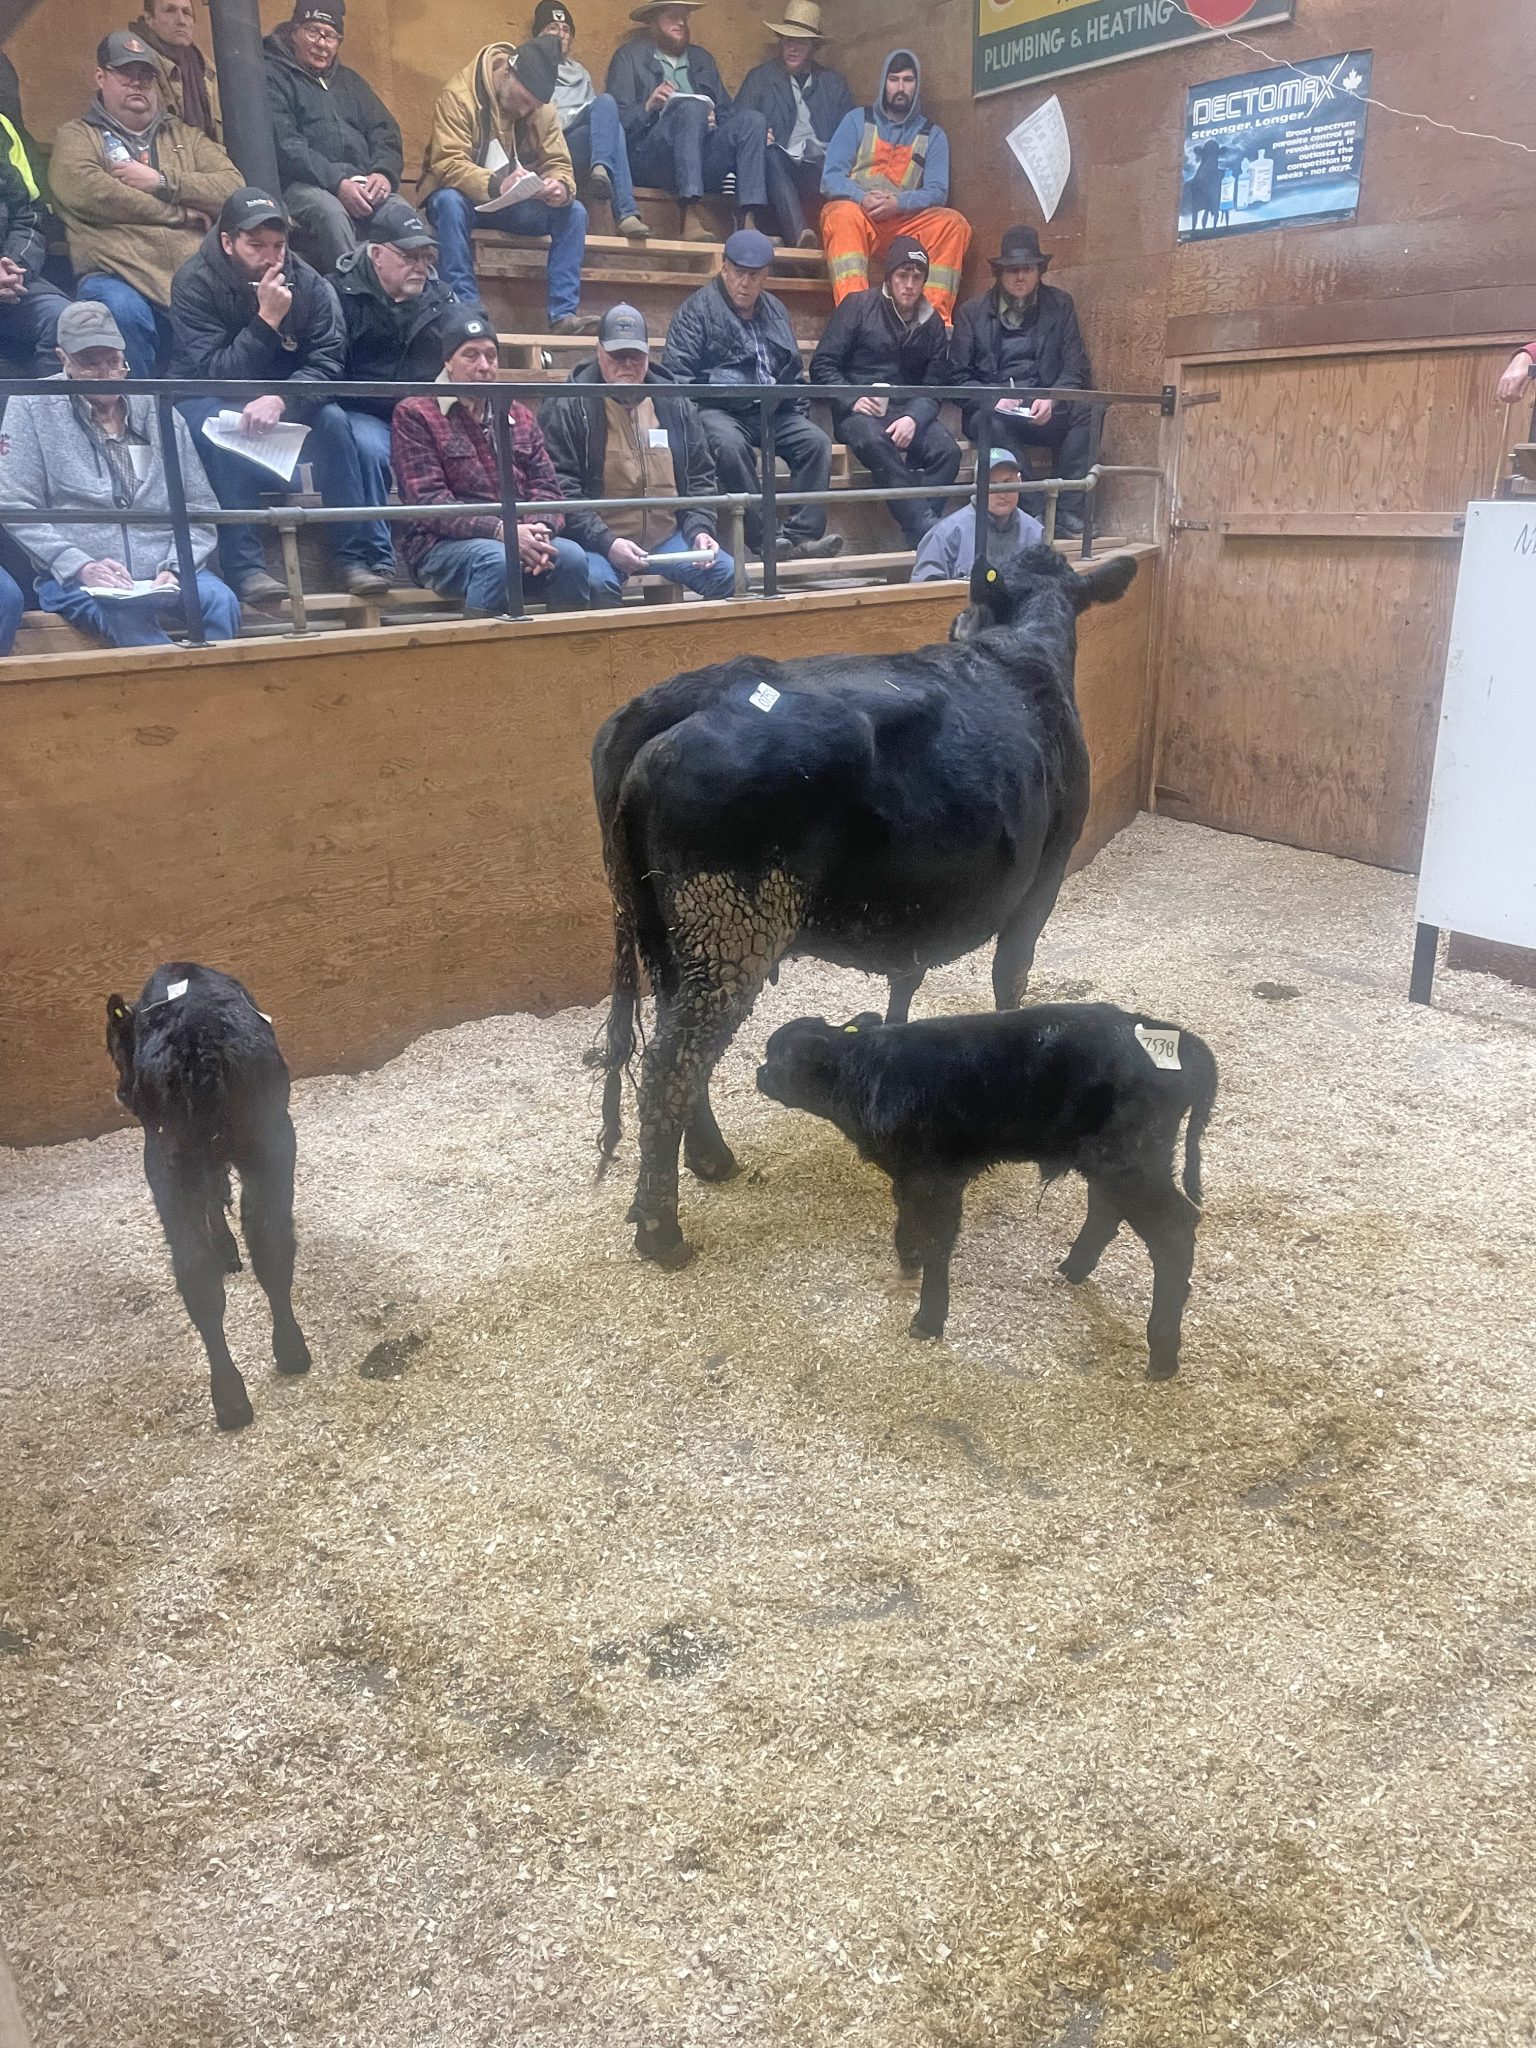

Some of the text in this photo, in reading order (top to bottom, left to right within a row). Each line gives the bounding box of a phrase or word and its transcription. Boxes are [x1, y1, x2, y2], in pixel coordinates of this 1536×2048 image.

[984, 1, 1175, 72] PLUMBING & HEATING
[1192, 53, 1349, 126] DECTOMAX
[1255, 111, 1307, 128] Longer.
[1313, 120, 1356, 133] spectrum
[1272, 129, 1355, 149] parasite control so
[1346, 137, 1354, 145] it
[1298, 146, 1354, 160] outlasts the
[1286, 155, 1354, 171] competition by
[1276, 171, 1304, 181] weeks
[1310, 167, 1327, 175] not
